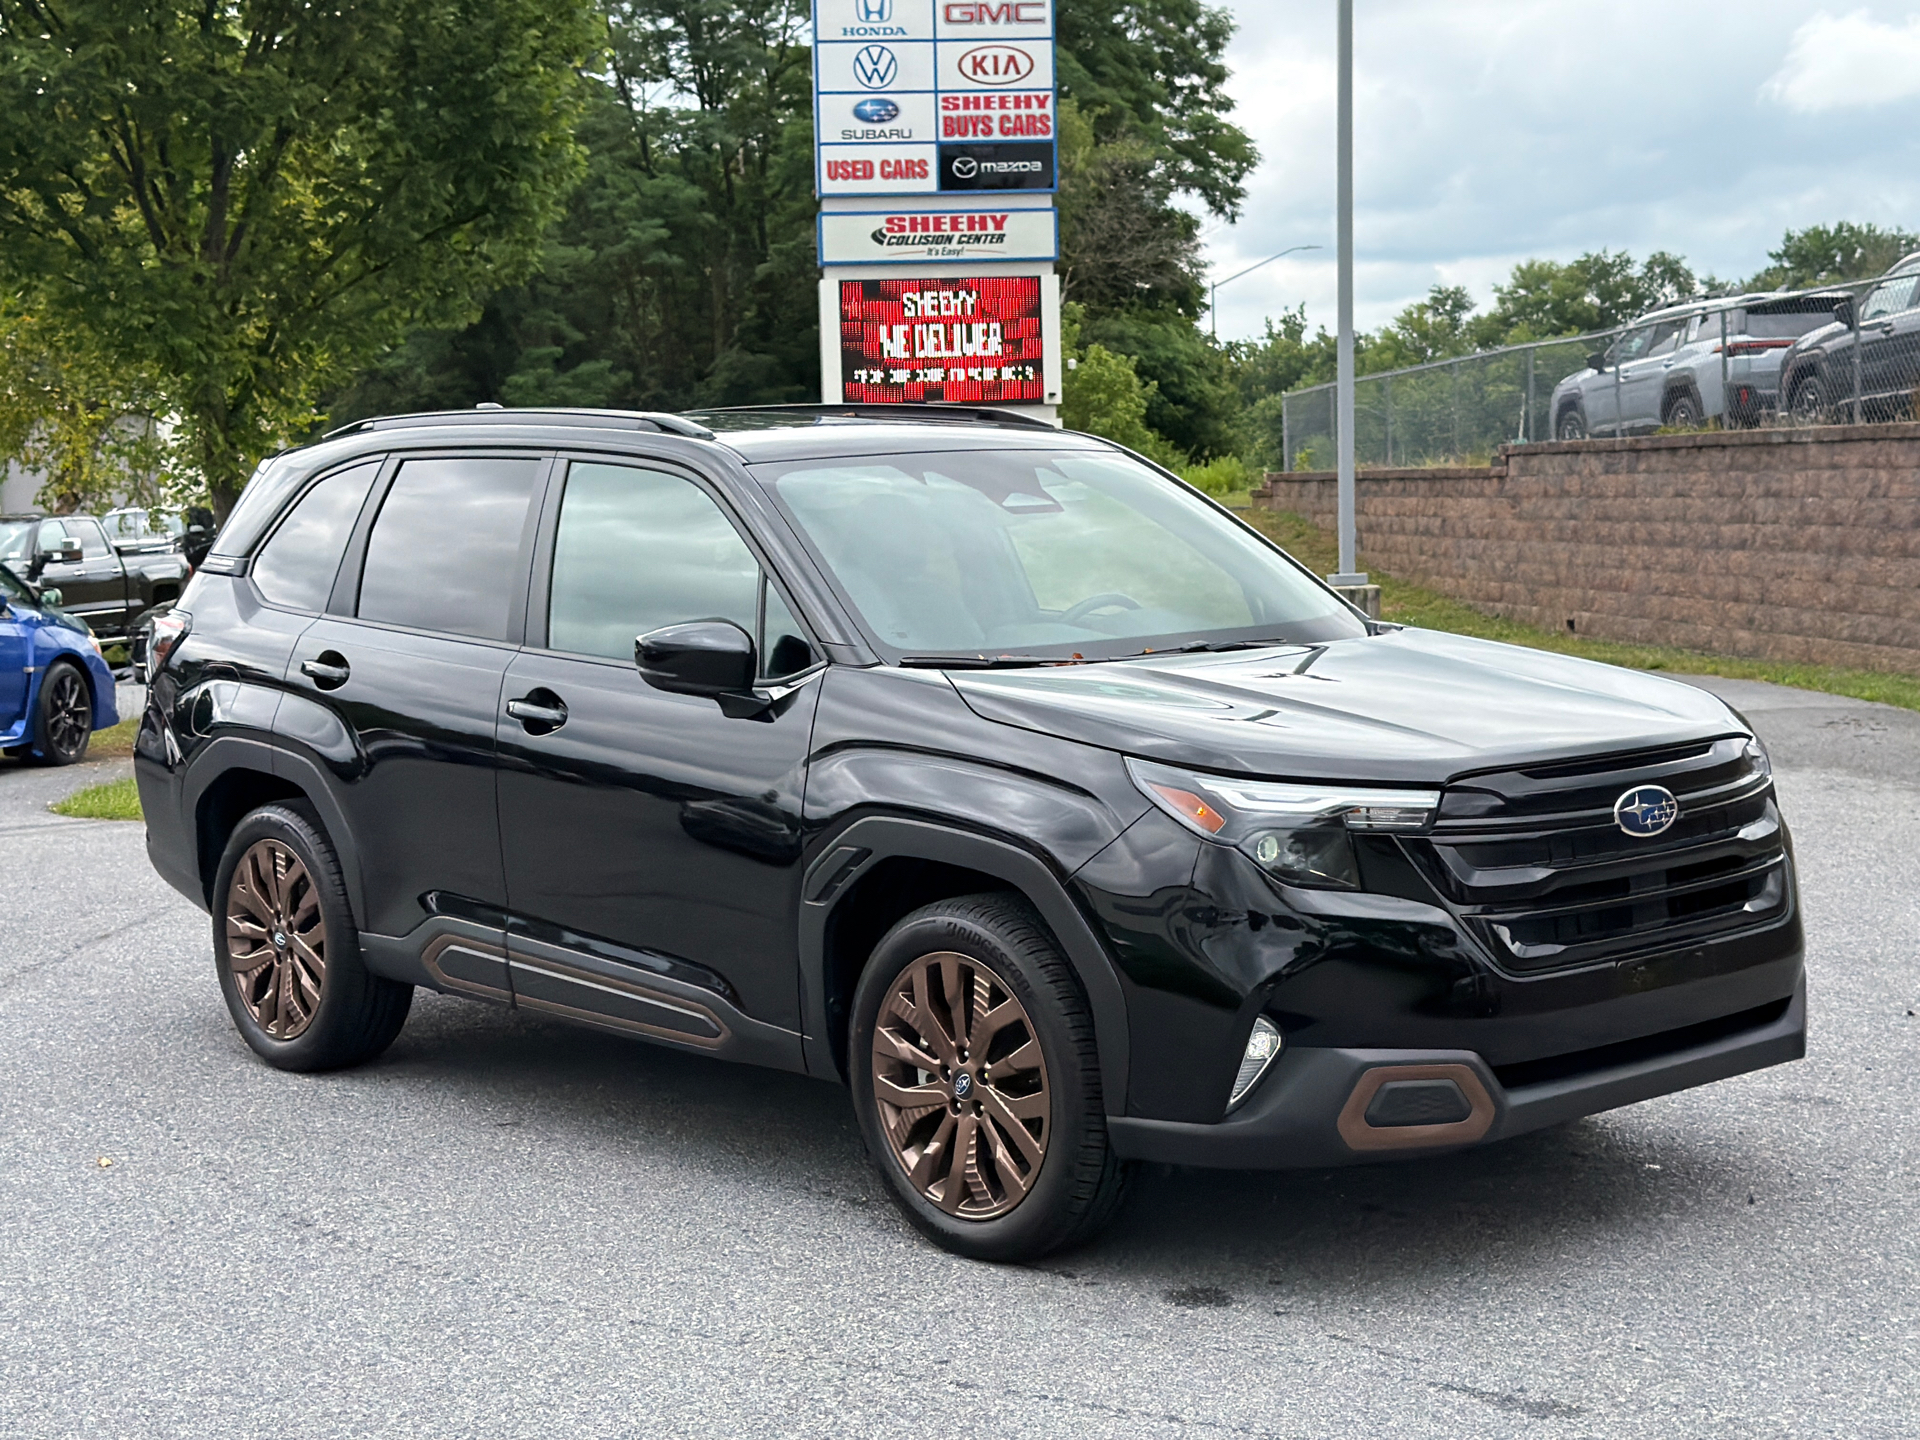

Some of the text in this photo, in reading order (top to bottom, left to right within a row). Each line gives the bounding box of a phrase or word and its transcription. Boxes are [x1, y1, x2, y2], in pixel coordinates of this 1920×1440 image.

[944, 2, 1045, 25] GMC
[842, 27, 908, 36] HONDA
[972, 55, 1021, 76] KIA
[941, 94, 1050, 111] SHEEHY
[841, 129, 912, 140] SUBARU
[943, 114, 1051, 137] BUYS CARS
[826, 158, 929, 181] USED CARS
[885, 214, 1009, 233] SHEEHY
[887, 233, 1006, 246] COLLISION CENTER
[926, 246, 965, 257] It's Easy!
